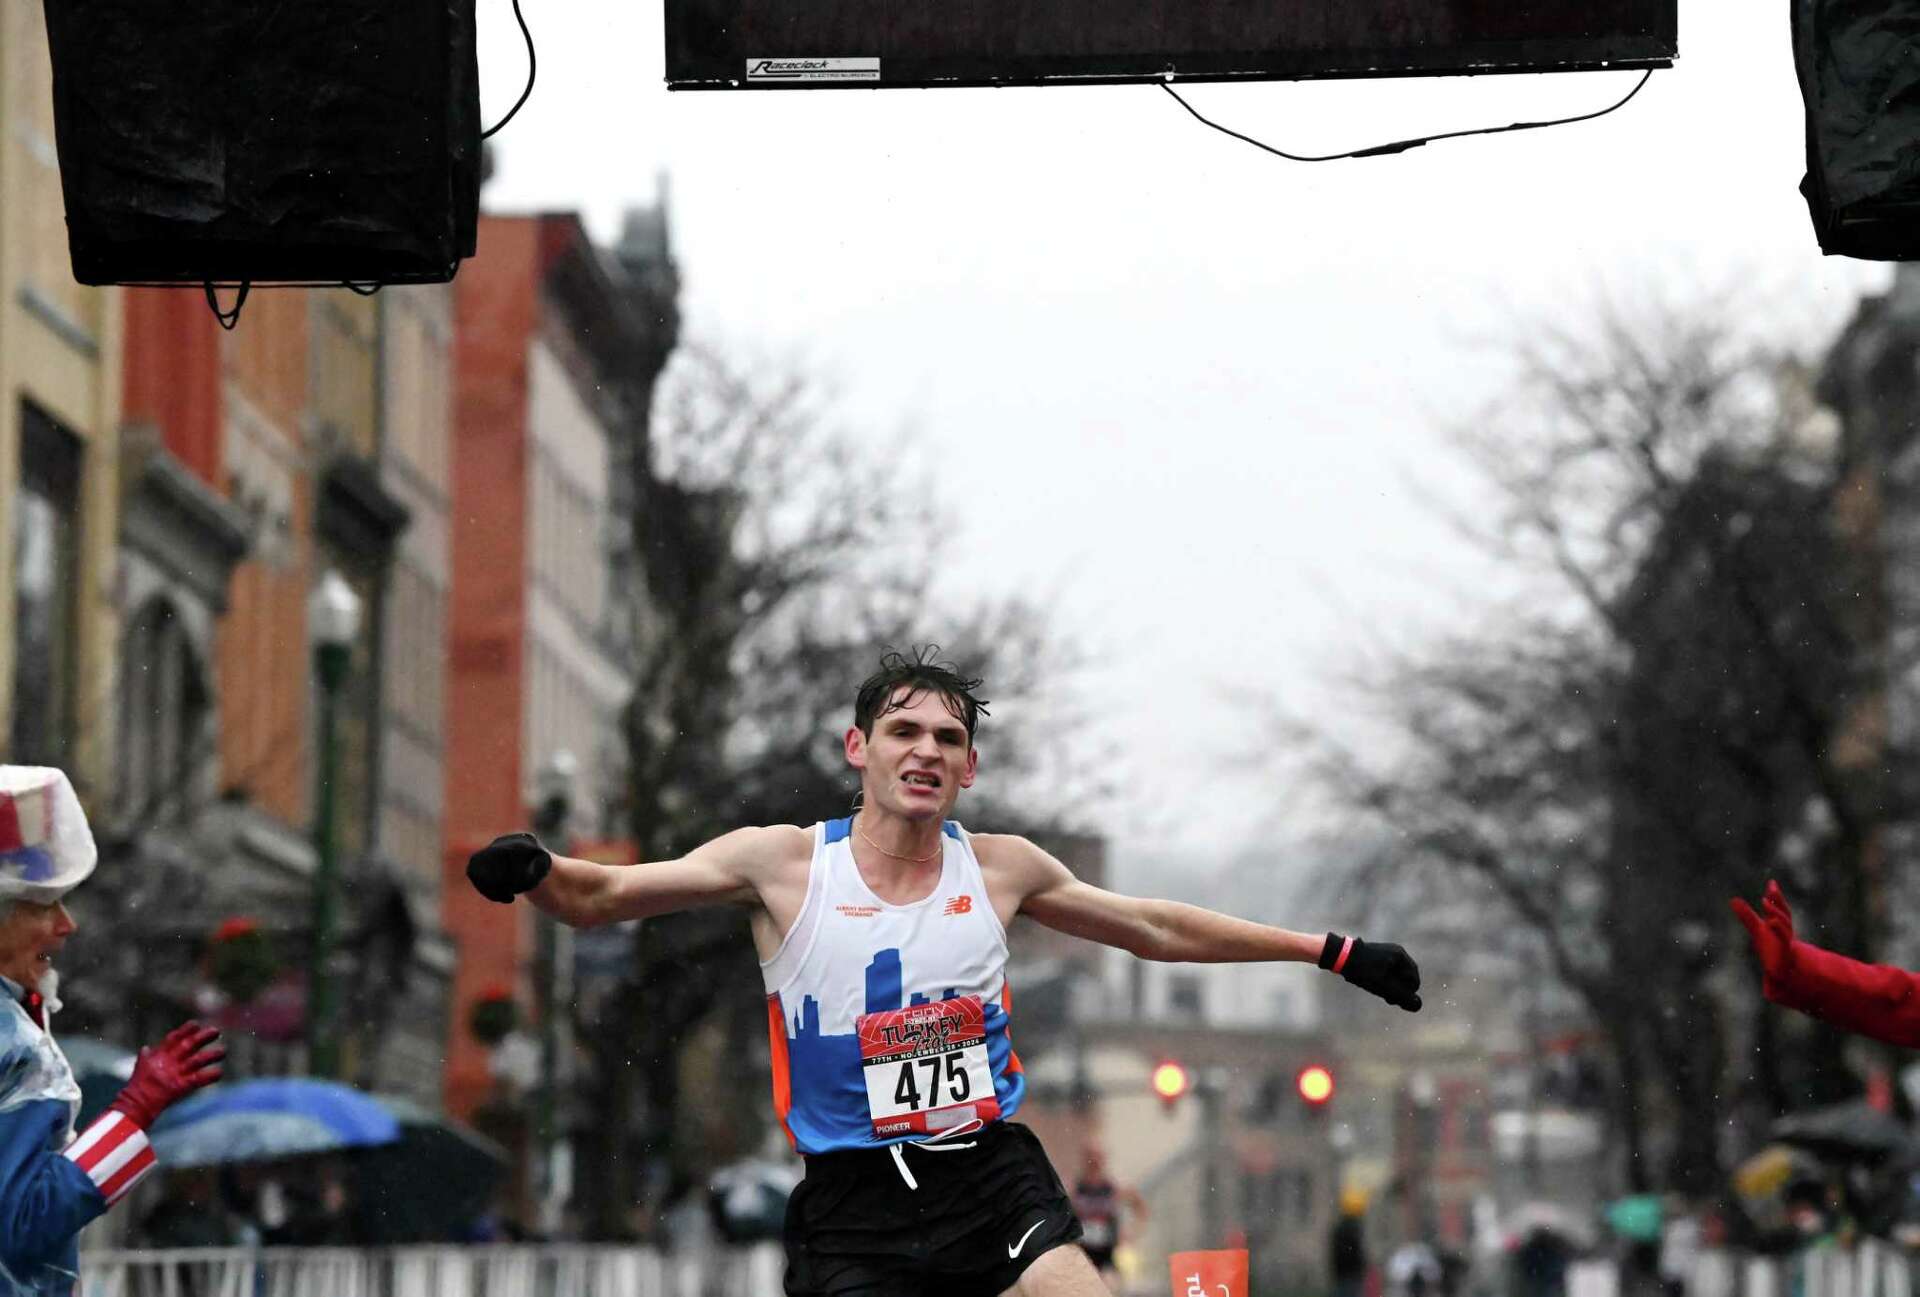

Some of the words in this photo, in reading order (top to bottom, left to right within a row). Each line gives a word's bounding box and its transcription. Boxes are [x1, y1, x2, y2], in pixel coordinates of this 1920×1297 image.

[749, 60, 829, 73] Raceclock
[881, 1013, 964, 1047] TURKEY
[871, 1055, 892, 1065] 77TH
[962, 1038, 980, 1047] 2024
[894, 1051, 970, 1110] 475
[876, 1121, 911, 1134] PIONEER
